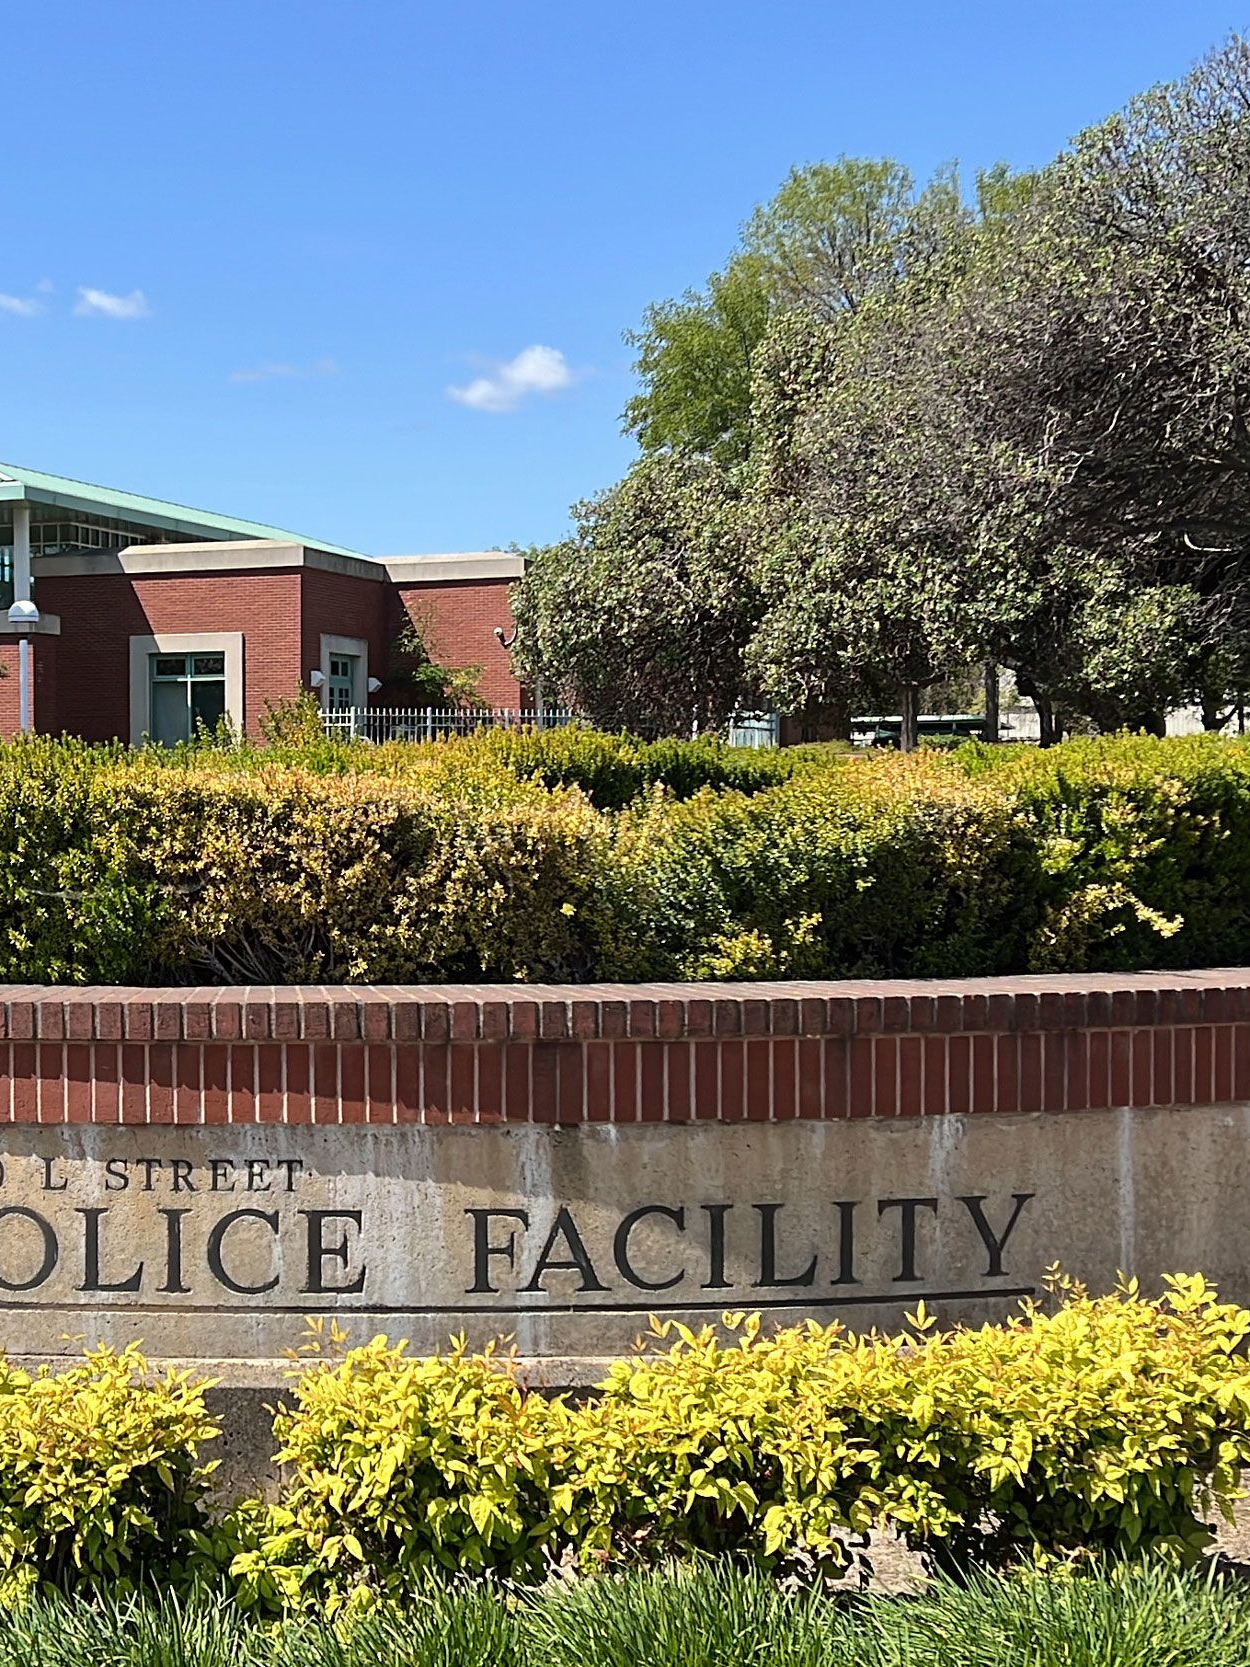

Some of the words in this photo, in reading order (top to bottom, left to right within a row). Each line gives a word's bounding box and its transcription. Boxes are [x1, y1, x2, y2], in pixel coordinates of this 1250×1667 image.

[42, 1157, 68, 1191] L
[105, 1158, 304, 1193] STREET
[464, 1193, 1036, 1294] FACILITY
